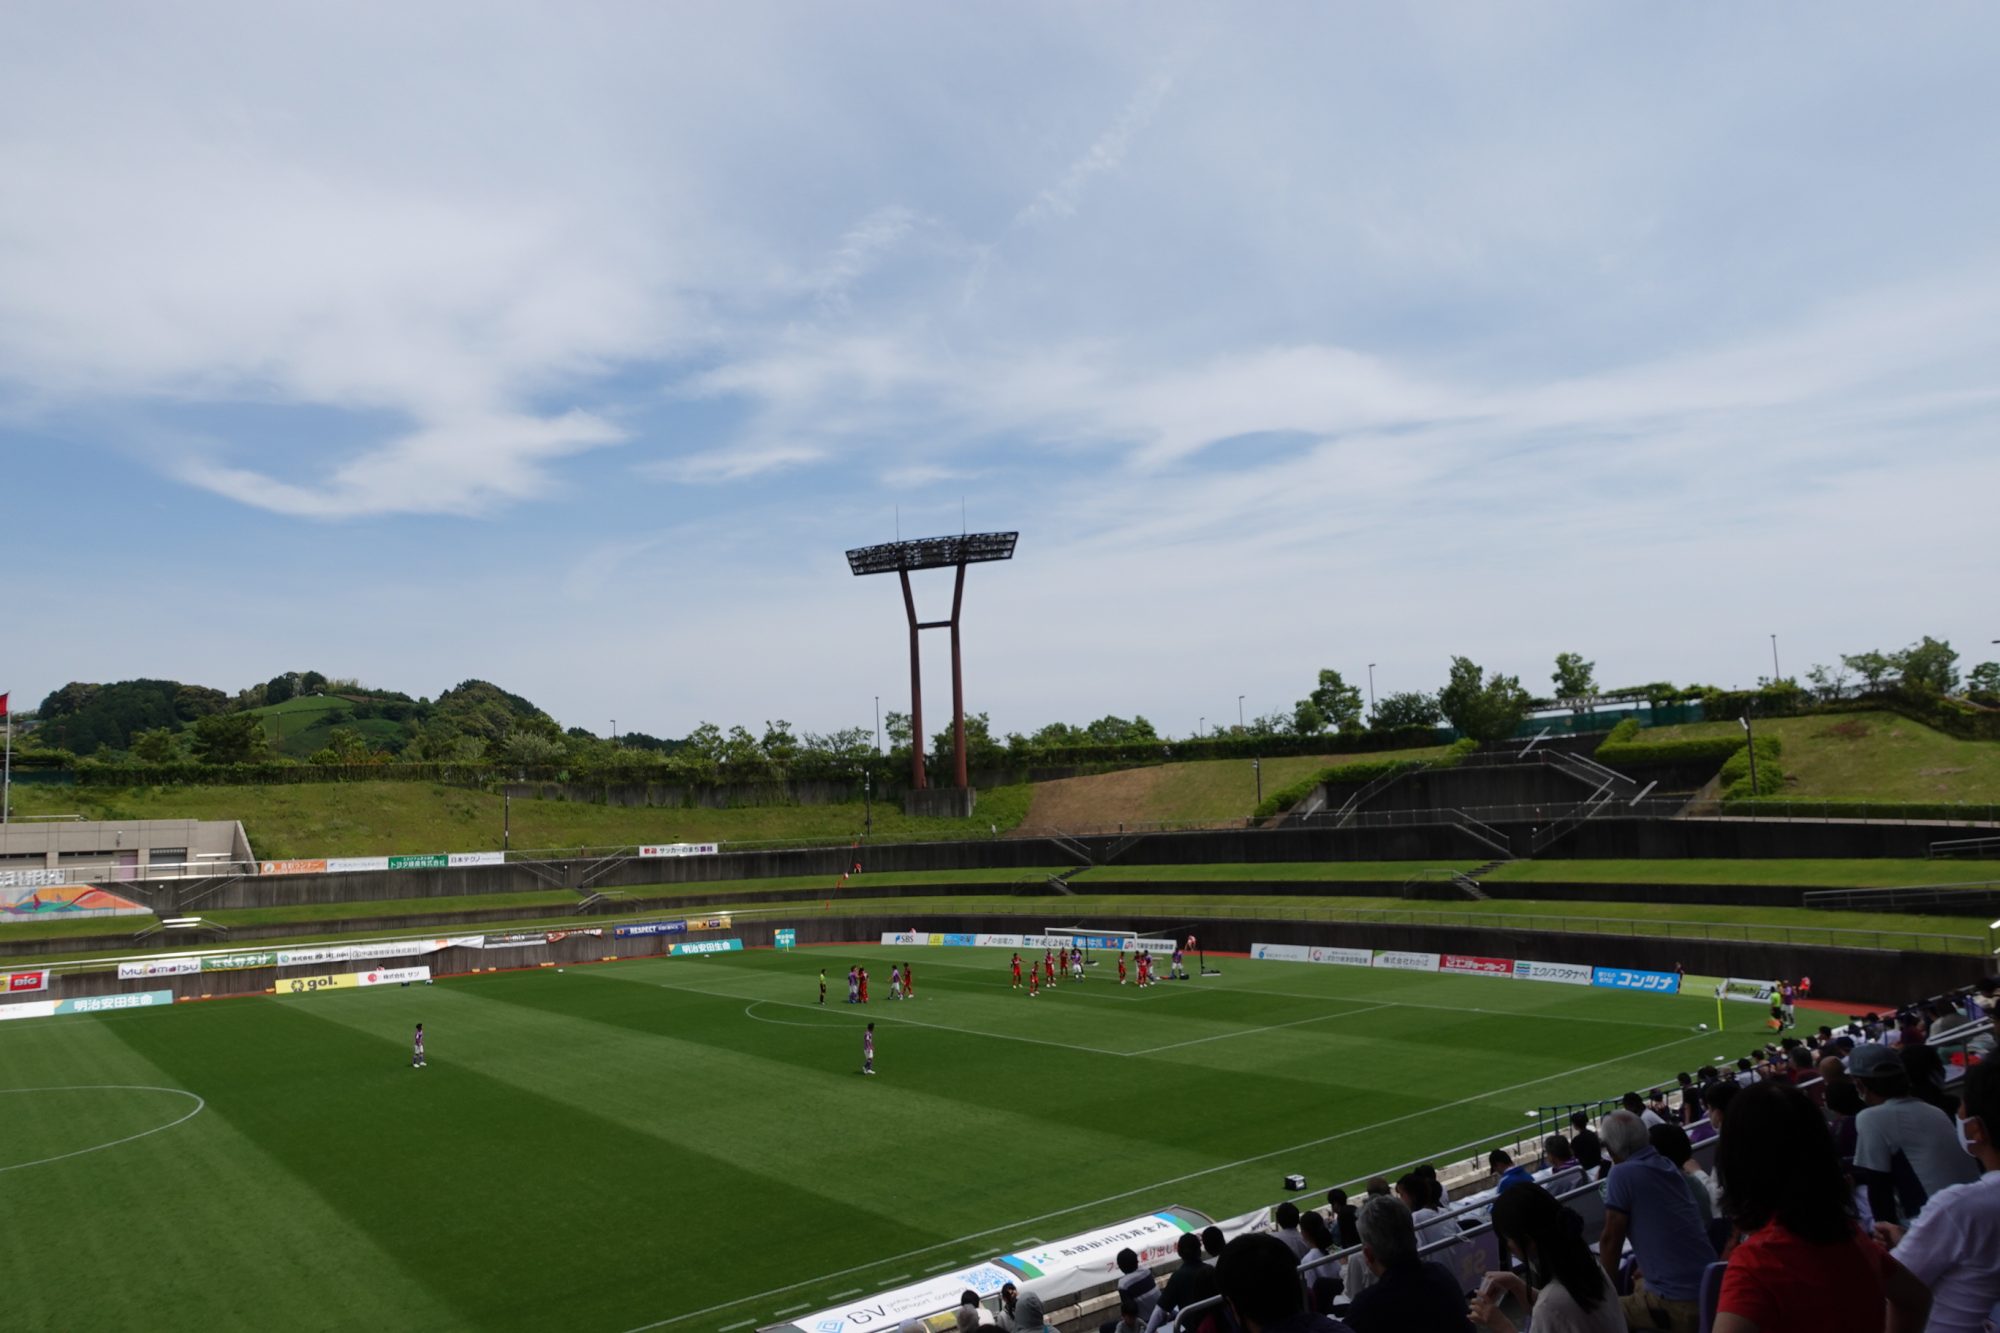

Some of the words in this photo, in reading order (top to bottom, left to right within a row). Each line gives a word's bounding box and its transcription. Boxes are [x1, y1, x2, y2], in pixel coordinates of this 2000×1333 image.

[681, 940, 731, 954] 明治安田生命
[1616, 972, 1674, 990] コンツナ
[74, 994, 153, 1011] 明治安田生命
[847, 1304, 886, 1325] GV
